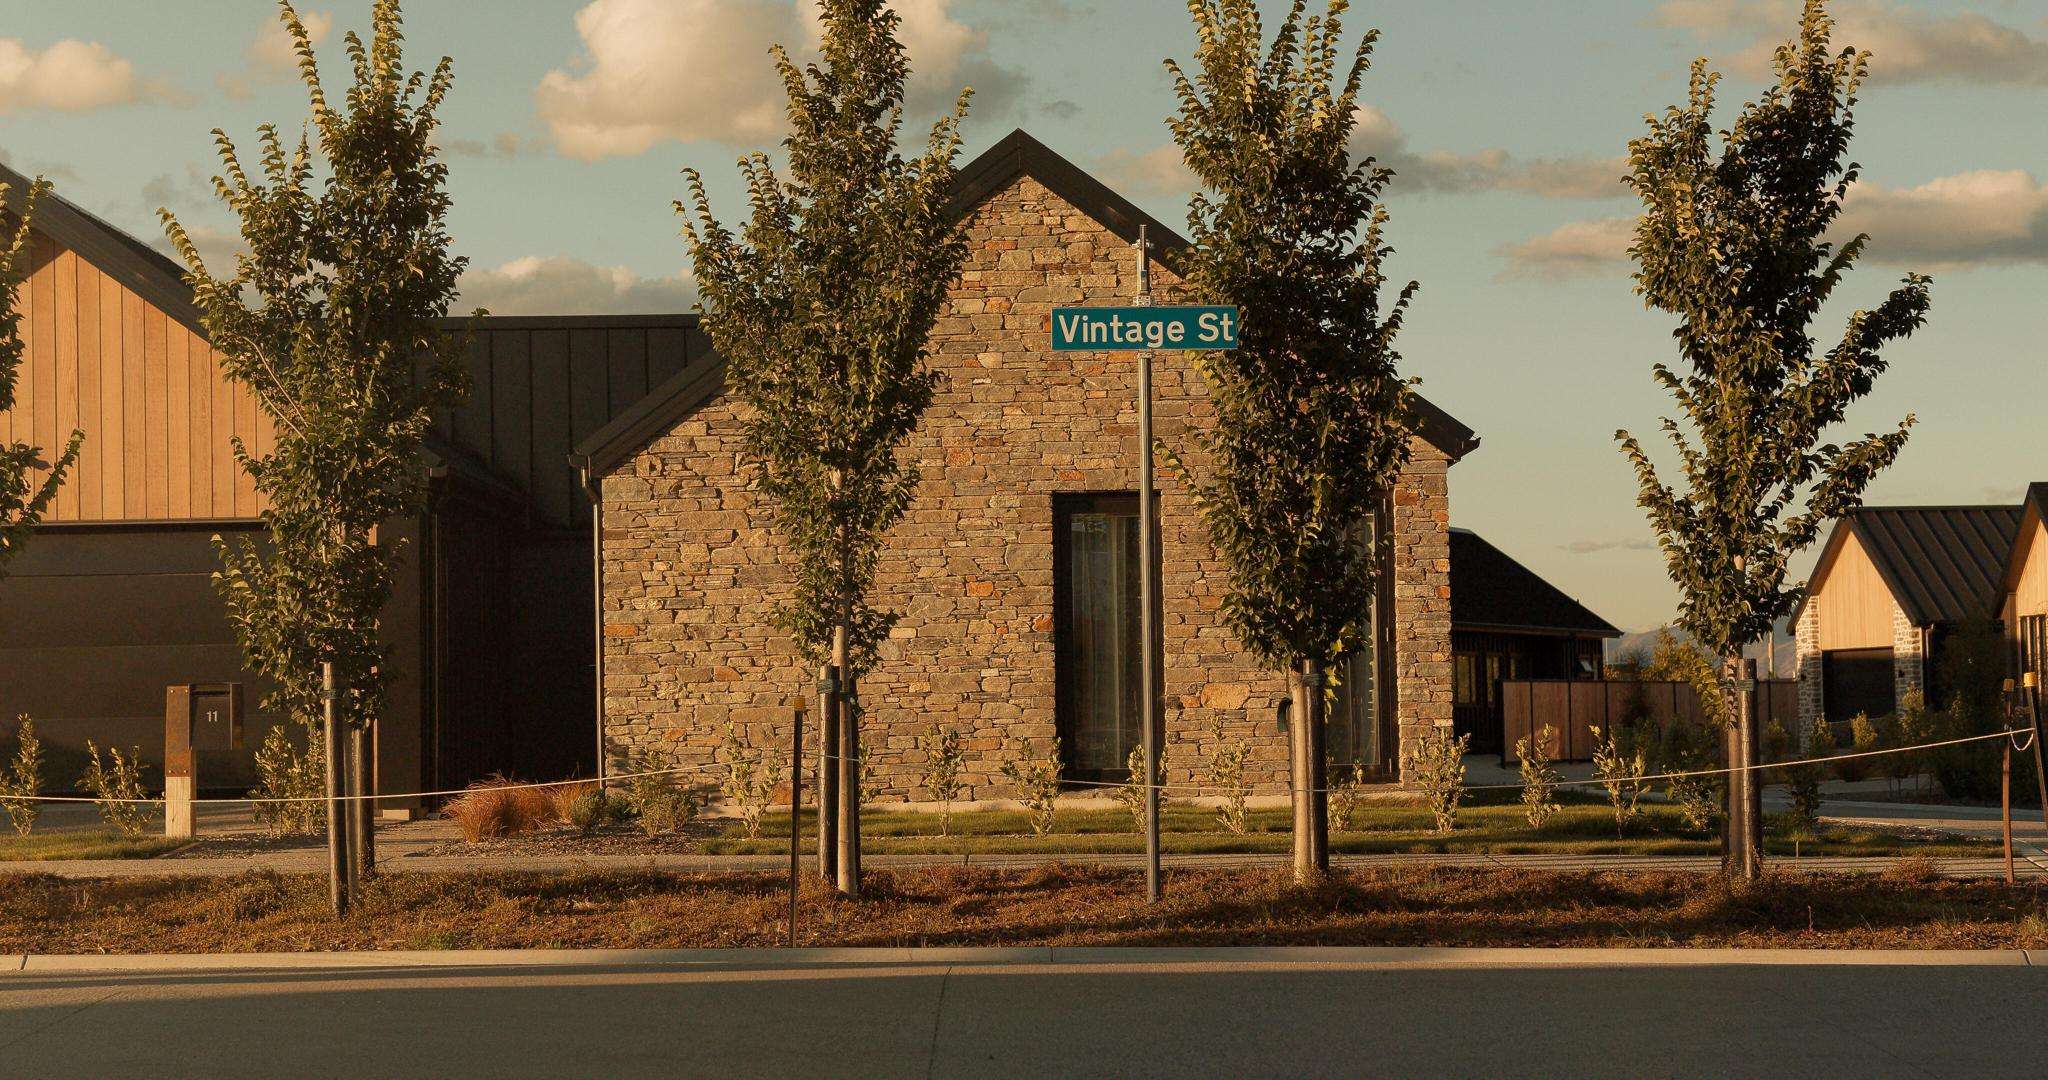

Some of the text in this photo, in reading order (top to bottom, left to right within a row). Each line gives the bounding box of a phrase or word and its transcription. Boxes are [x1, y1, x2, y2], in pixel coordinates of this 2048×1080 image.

[1058, 312, 1233, 348] Vintage St
[206, 710, 218, 723] 11
